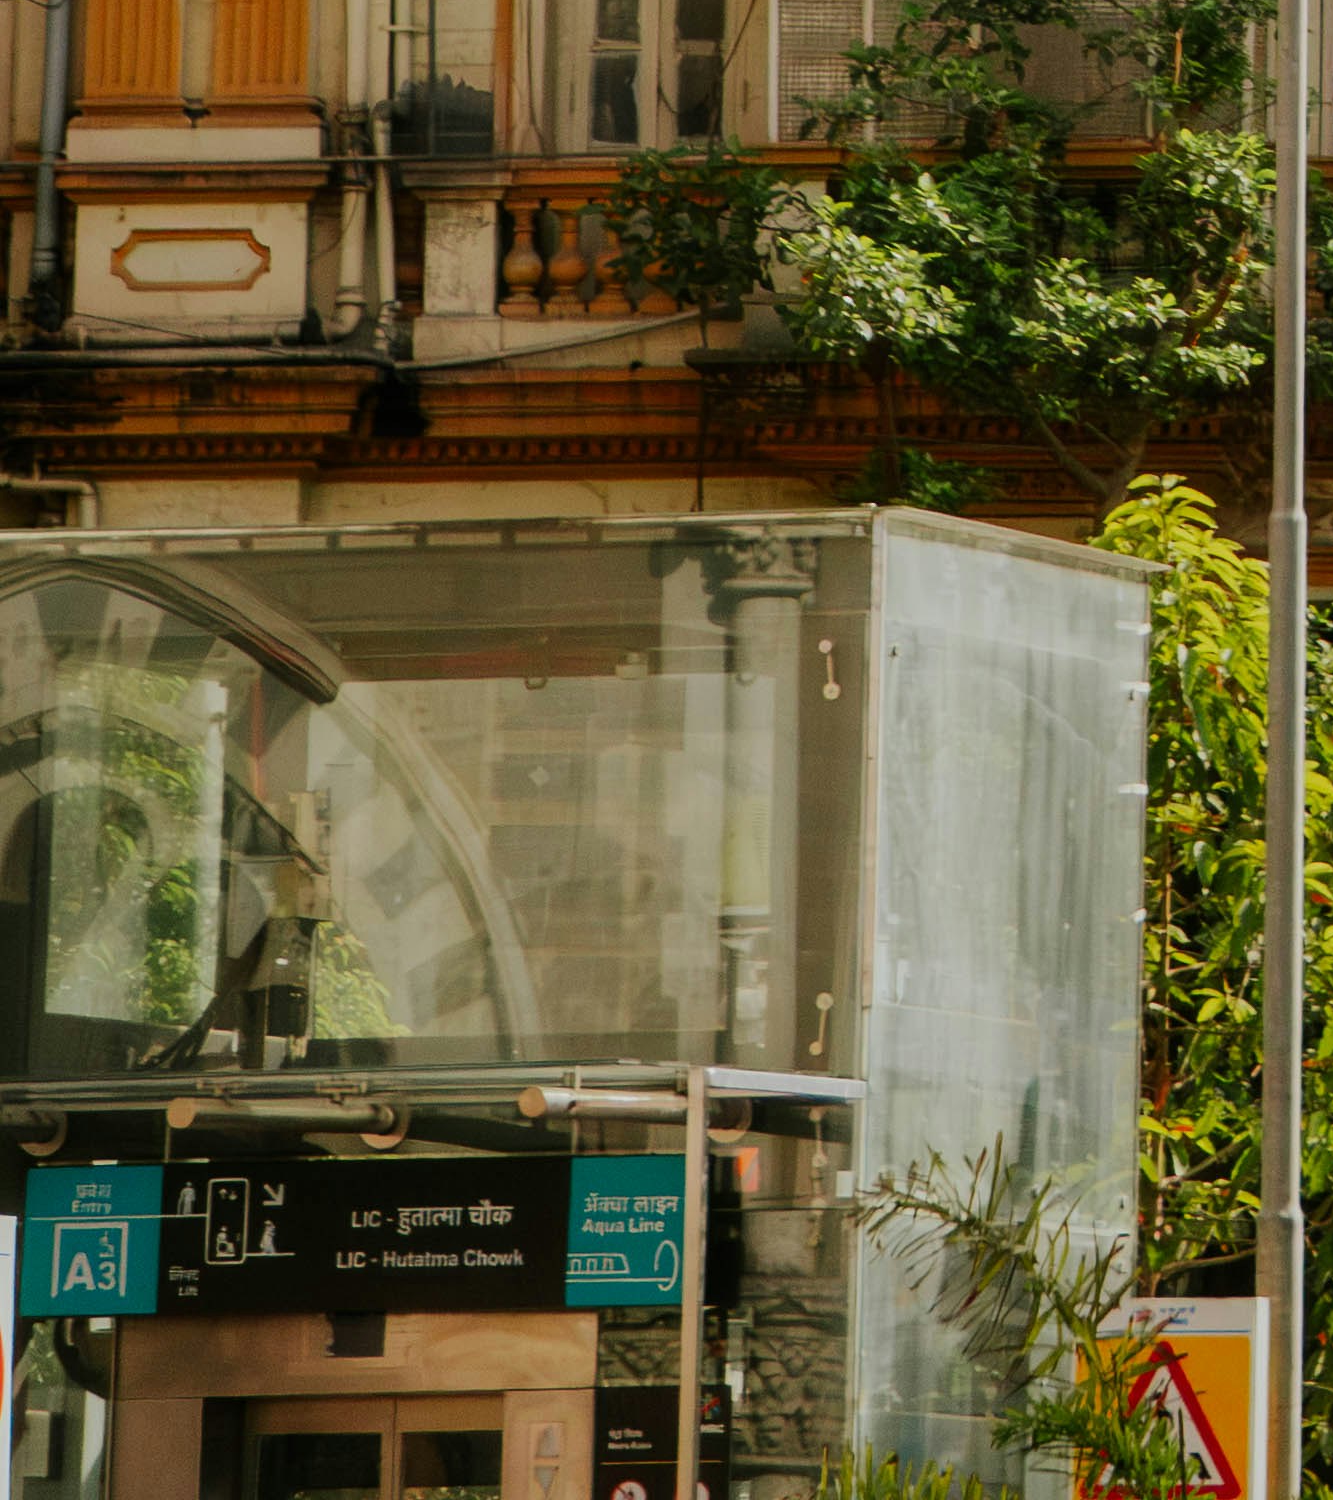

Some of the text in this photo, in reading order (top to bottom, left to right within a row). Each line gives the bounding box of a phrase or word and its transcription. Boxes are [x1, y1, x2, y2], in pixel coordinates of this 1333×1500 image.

[71, 1199, 112, 1215] Entry
[351, 1210, 382, 1228] LIC
[468, 1199, 515, 1226] चौक
[582, 1217, 665, 1236] Aqua Line
[336, 1251, 366, 1269] LIC
[382, 1250, 459, 1268] Hutatma
[463, 1248, 525, 1267] Chowk
